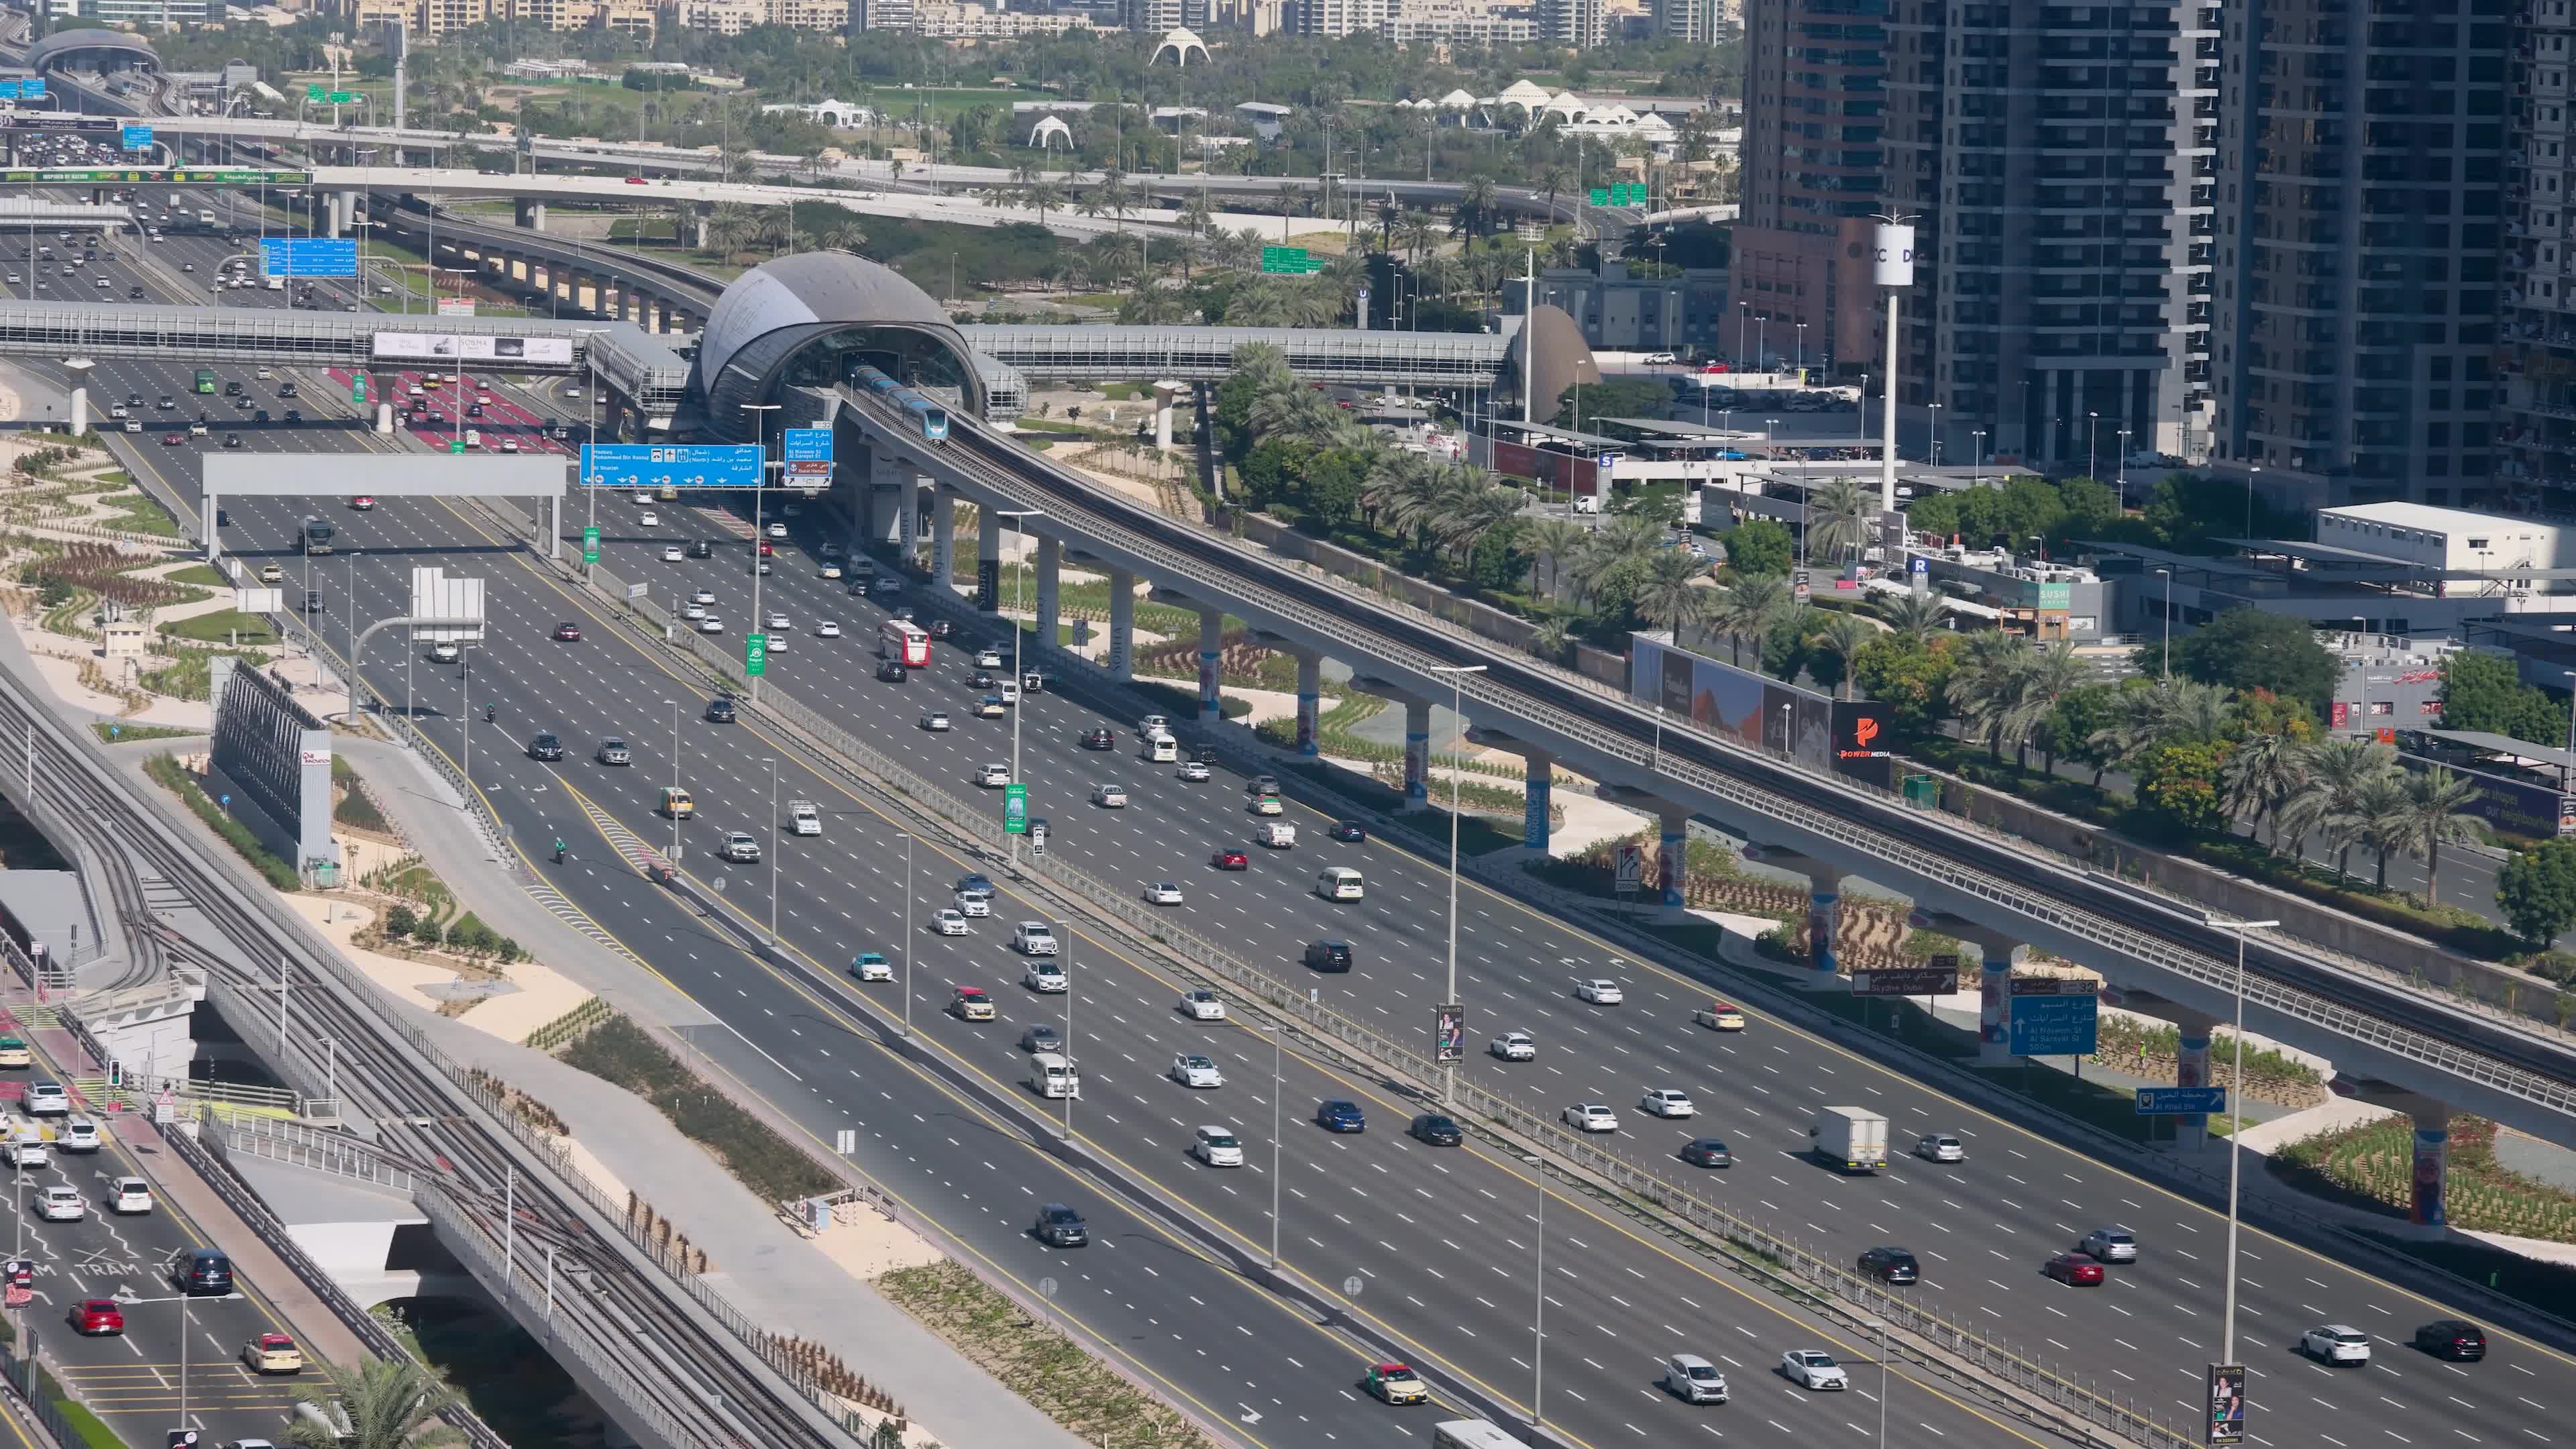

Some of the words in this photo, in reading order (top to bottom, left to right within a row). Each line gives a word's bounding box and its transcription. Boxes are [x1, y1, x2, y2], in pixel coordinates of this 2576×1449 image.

[1602, 456, 1611, 466] S
[1915, 559, 1926, 571] R
[1113, 627, 1122, 671] SOBHA
[2491, 788, 2518, 806] shapes
[2485, 805, 2500, 816] our
[2500, 809, 2555, 829] neighbourhoo
[1872, 984, 1899, 993] Skydive
[2082, 982, 2094, 992] 32
[74, 1263, 142, 1275] TRAM
